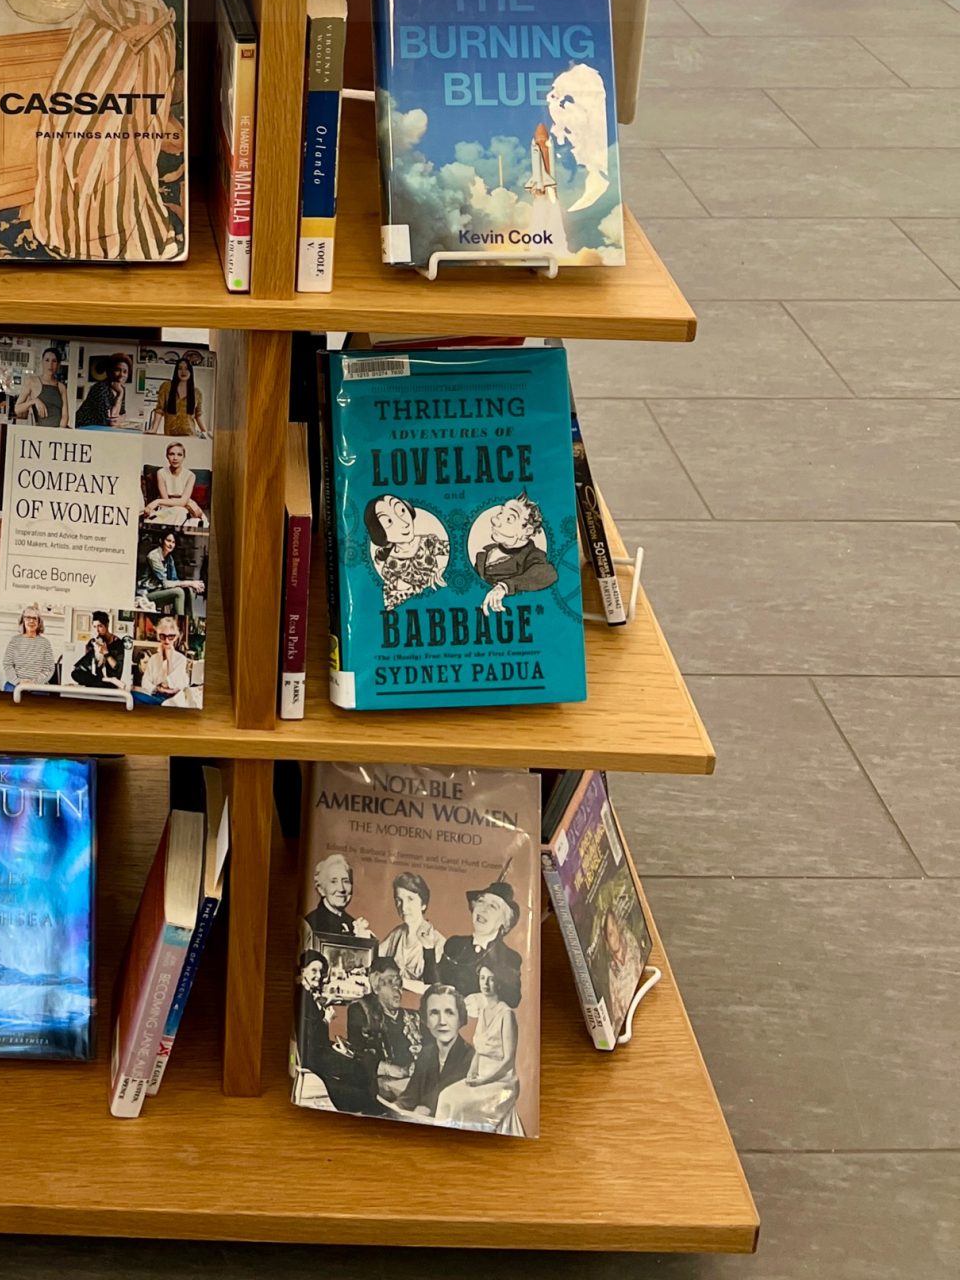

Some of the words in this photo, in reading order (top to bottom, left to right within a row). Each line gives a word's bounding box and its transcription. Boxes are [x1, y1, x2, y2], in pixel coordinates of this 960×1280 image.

[400, 25, 595, 61] BURNING
[445, 72, 554, 106] BLUE
[36, 131, 102, 140] PAINTINGS
[104, 131, 131, 140] AND
[134, 131, 181, 141] PRINTS
[240, 126, 250, 153] NAMED
[240, 155, 249, 169] ME
[312, 126, 328, 185] Orlando
[233, 170, 252, 223] MALALA
[459, 230, 504, 246] Kevin
[509, 230, 554, 245] Cook
[374, 397, 525, 421] THRILLING
[390, 427, 487, 440] ADVENTURES
[495, 427, 514, 438] OF
[19, 439, 42, 460] IN
[48, 442, 92, 464] THE
[371, 445, 534, 487] LOVELACE
[18, 470, 119, 498] COMPANY
[444, 490, 465, 500] and
[15, 498, 44, 520] OF
[49, 503, 130, 528] WOMEN
[48, 531, 58, 539] and
[84, 545, 125, 555] Entrepreneurs
[593, 542, 607, 556] 50
[12, 563, 48, 580] Grace
[50, 567, 97, 587] Bonney
[289, 614, 300, 634] Rosa
[380, 605, 534, 650] BABBAGE
[288, 635, 299, 660] Parks
[375, 664, 462, 686] SYDNEY
[471, 661, 545, 682] PADUA
[373, 775, 463, 800] NOTABLE
[316, 791, 424, 818] AMERICAN
[349, 820, 372, 833] THE
[376, 823, 432, 839] MODERN
[437, 830, 482, 846] PERIOD
